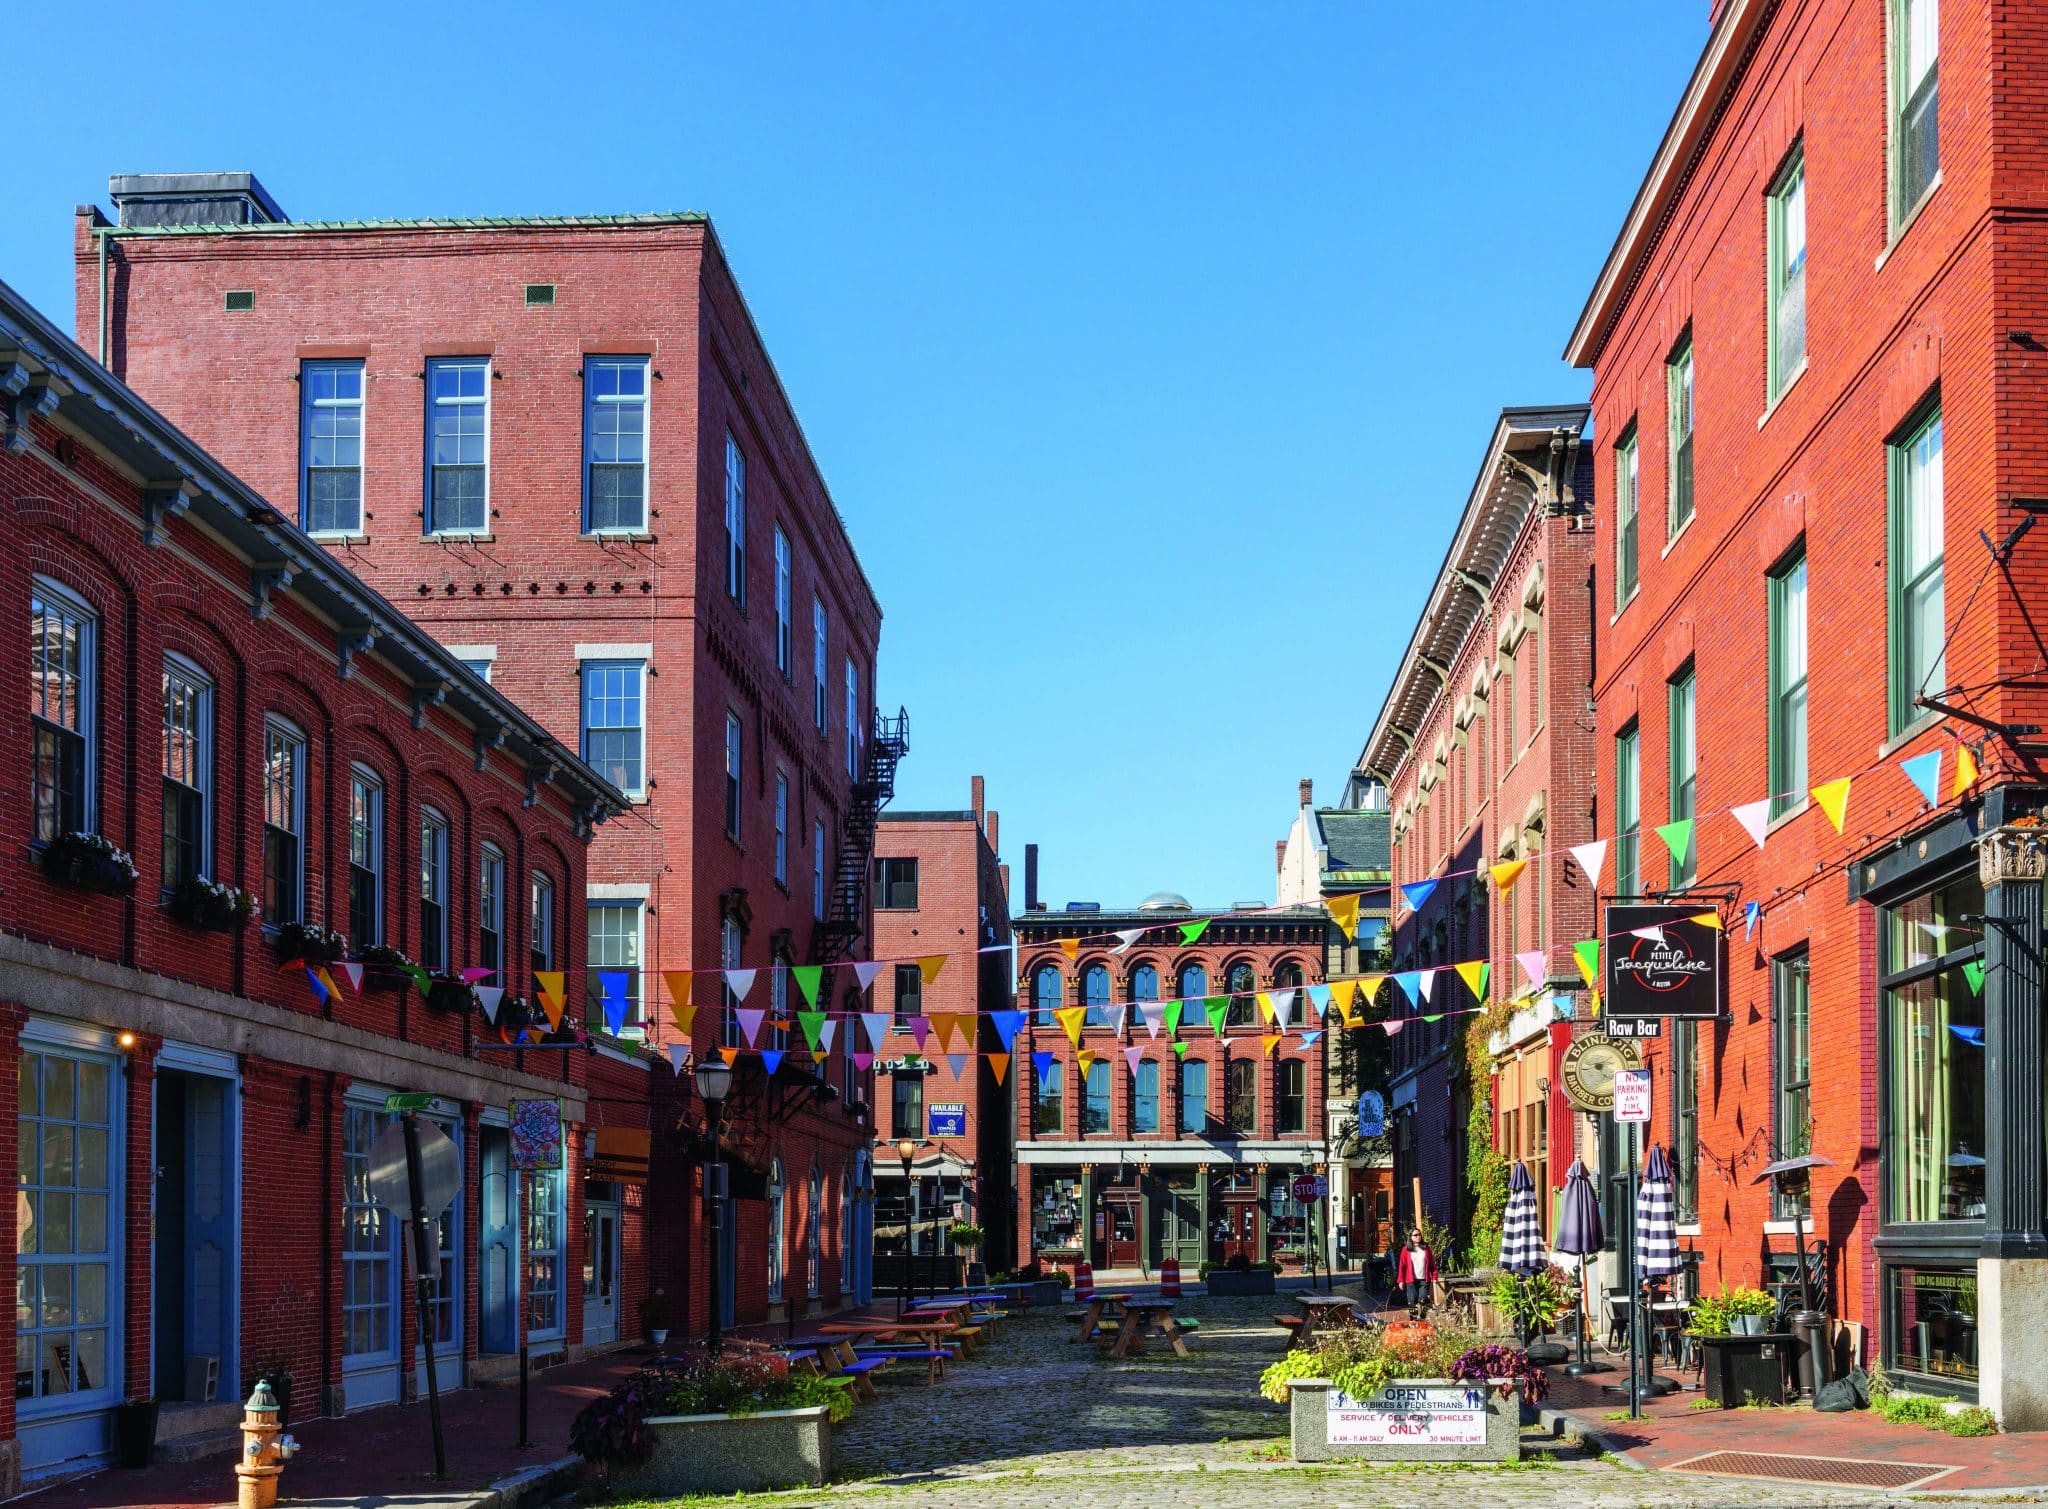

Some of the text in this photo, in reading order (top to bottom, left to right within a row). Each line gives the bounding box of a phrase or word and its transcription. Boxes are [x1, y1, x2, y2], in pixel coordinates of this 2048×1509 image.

[1651, 951, 1672, 960] PETITE
[1614, 949, 1711, 980] Jacqueline
[1609, 1019, 1658, 1036] Raw Bar
[1571, 1035, 1634, 1058] BLIND PIG
[1625, 1073, 1639, 1082] NO
[1566, 1074, 1596, 1105] BARBER
[1617, 1084, 1648, 1095] PARKING
[1385, 1388, 1427, 1400] OPEN
[1357, 1401, 1369, 1409] TO
[1369, 1401, 1395, 1409] BIKES
[1405, 1401, 1463, 1409] PEDESTRIANS
[1387, 1414, 1429, 1422] DELIVERY
[1388, 1424, 1425, 1435] ONLY
